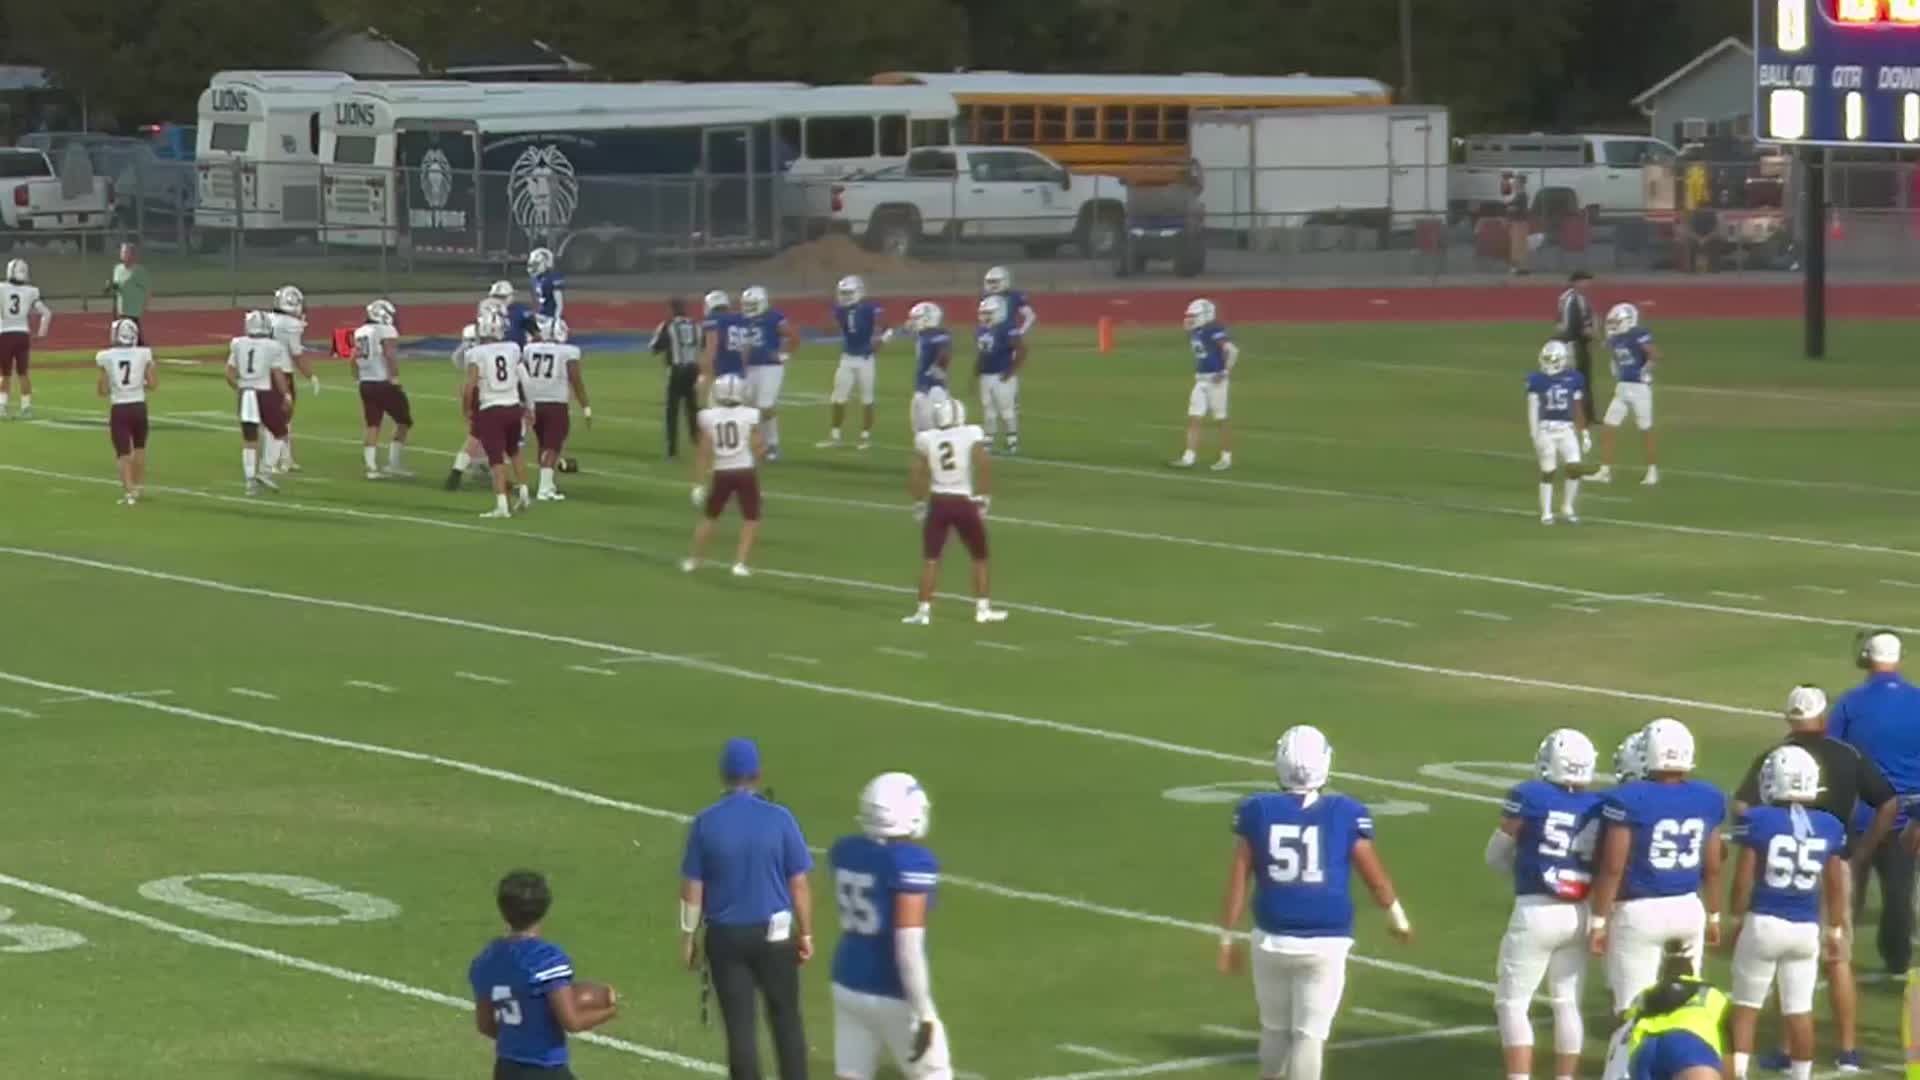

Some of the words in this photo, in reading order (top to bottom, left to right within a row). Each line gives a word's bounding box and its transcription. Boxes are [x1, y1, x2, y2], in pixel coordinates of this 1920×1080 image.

[211, 89, 248, 111] LIONS
[336, 102, 375, 126] LIONS
[9, 294, 20, 315] 3
[119, 360, 132, 386] 7
[247, 348, 255, 374] 1
[495, 356, 508, 381] 8
[533, 353, 554, 378] 77
[1545, 388, 1569, 410] 15
[716, 420, 739, 449] 10
[938, 442, 956, 471] 2
[1268, 824, 1324, 882] 51
[1649, 818, 1705, 868] 63
[1765, 834, 1828, 889] 65
